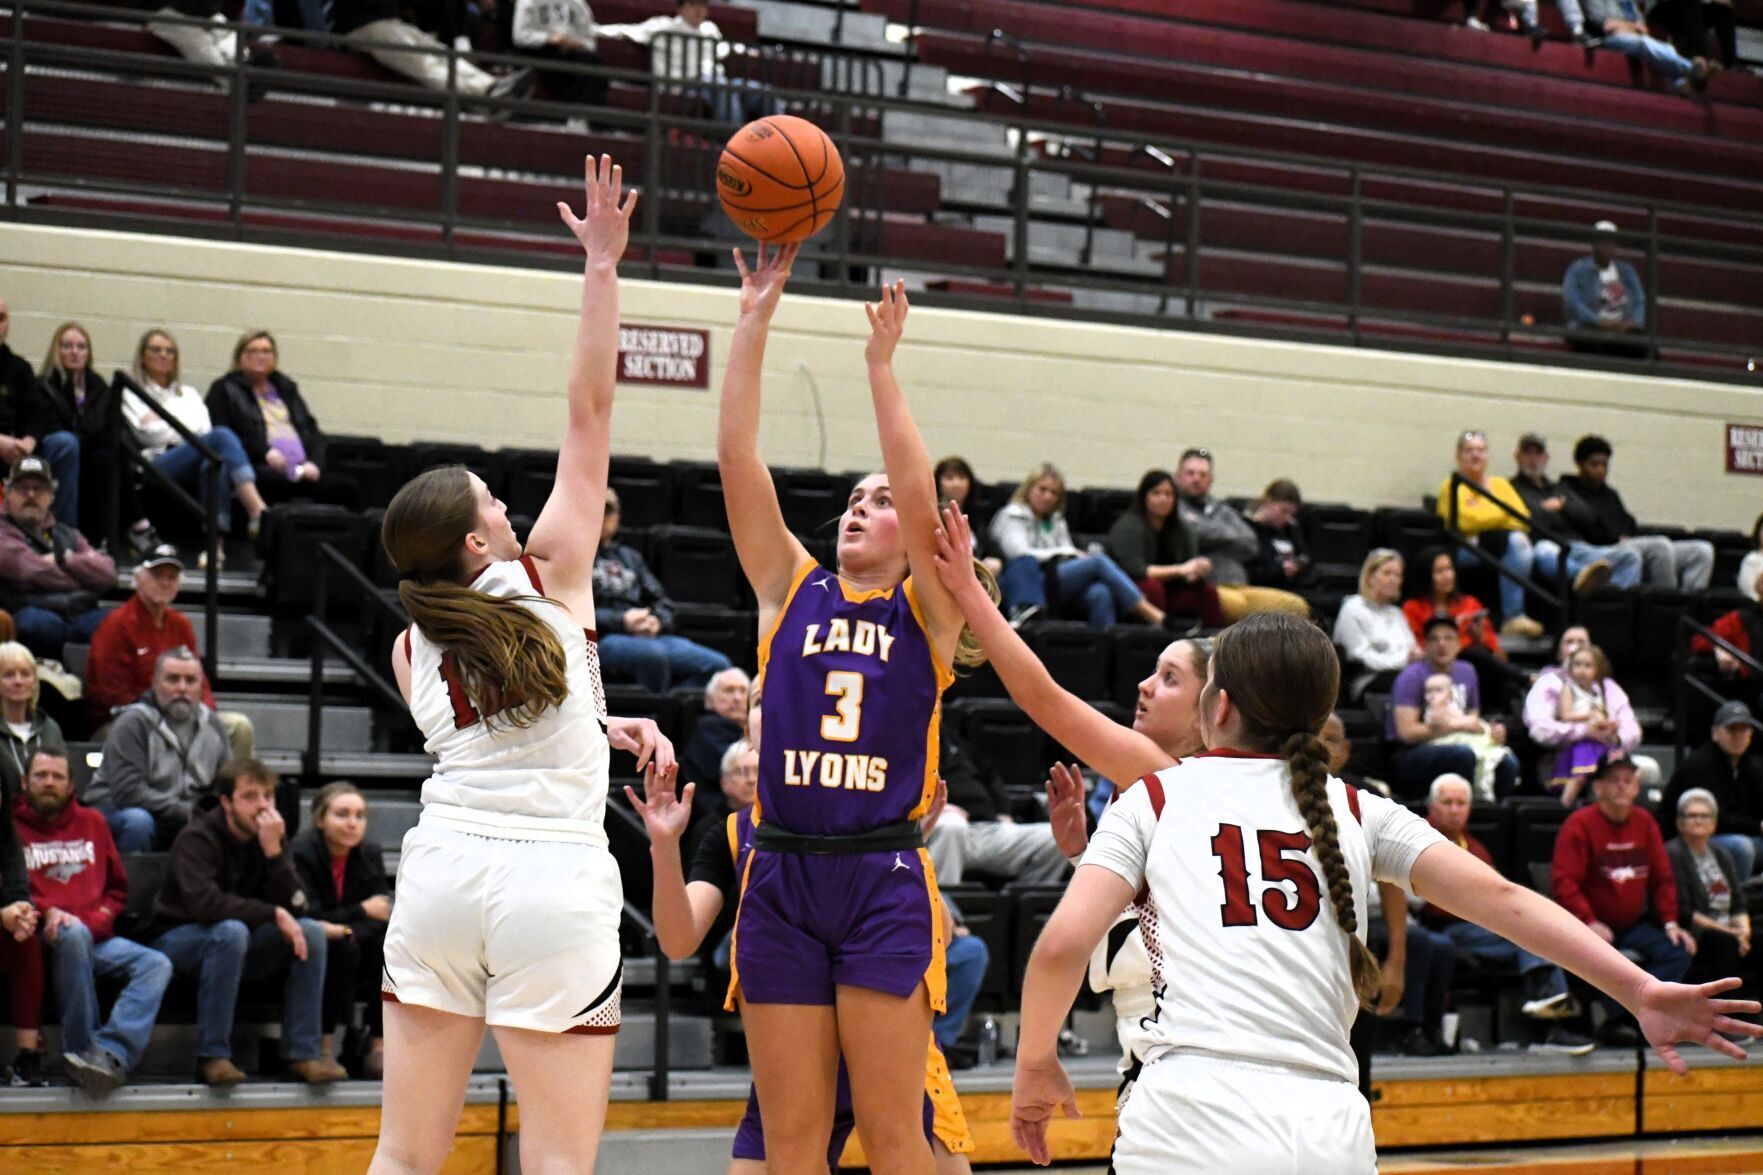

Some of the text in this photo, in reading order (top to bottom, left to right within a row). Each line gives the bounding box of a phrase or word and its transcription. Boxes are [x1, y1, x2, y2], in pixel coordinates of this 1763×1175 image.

[623, 352, 697, 381] SECTION
[802, 618, 895, 662] LADY
[820, 670, 864, 742] 3
[784, 749, 888, 792] LYONS
[1210, 822, 1323, 931] 15
